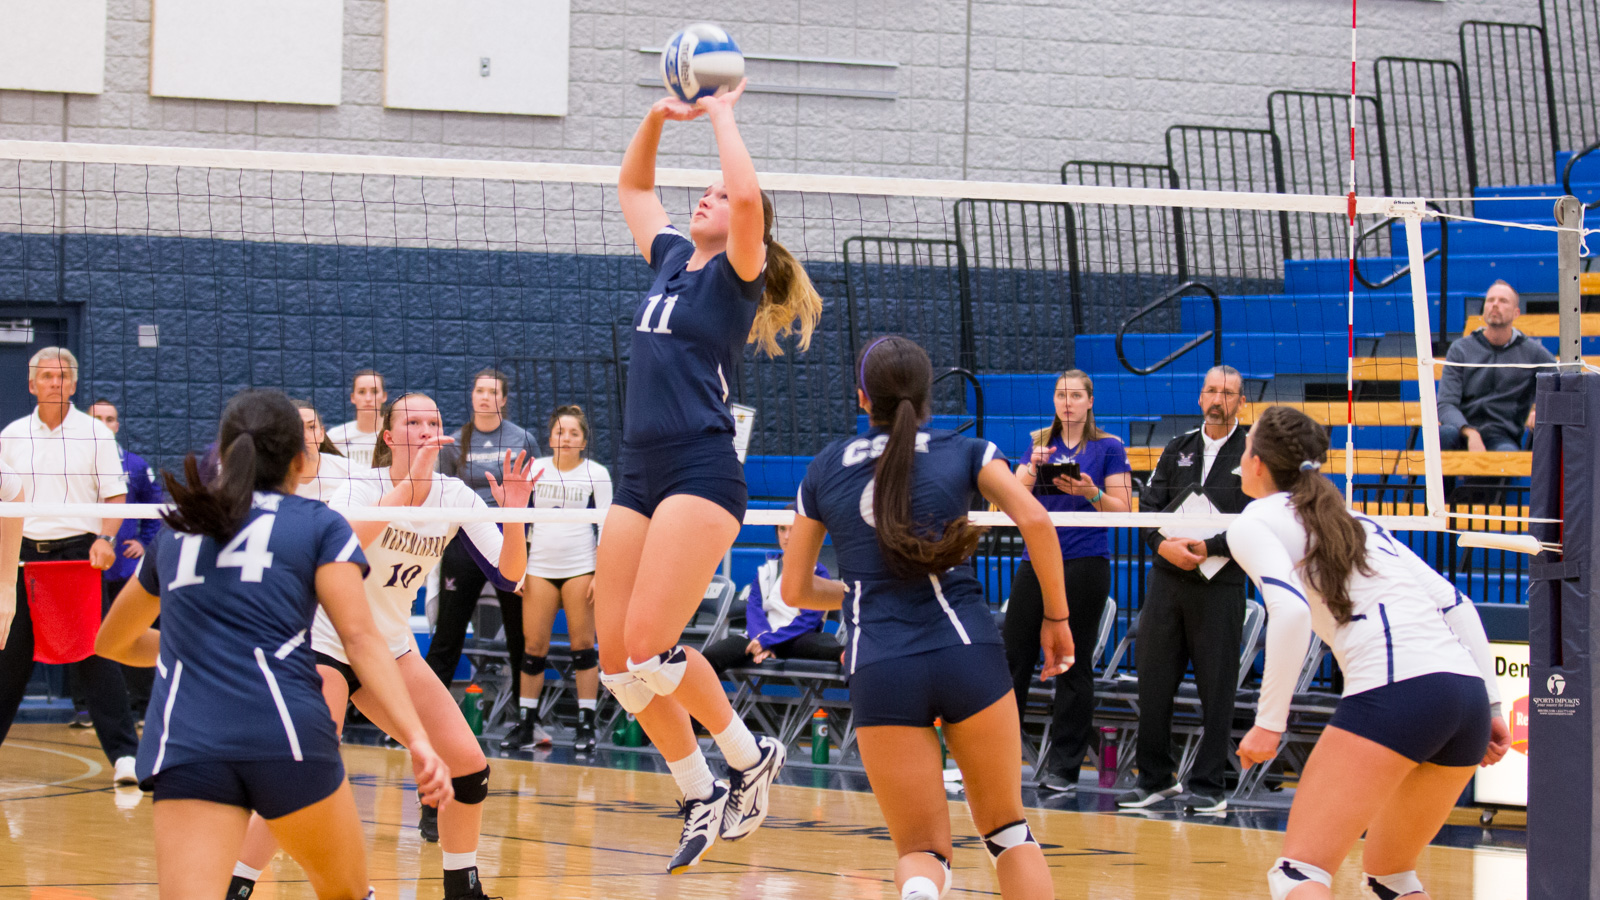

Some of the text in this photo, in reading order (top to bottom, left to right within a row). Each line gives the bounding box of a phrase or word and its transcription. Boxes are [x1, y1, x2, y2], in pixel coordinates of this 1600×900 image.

[636, 293, 679, 335] 11
[168, 513, 276, 591] 14
[382, 562, 422, 589] 10
